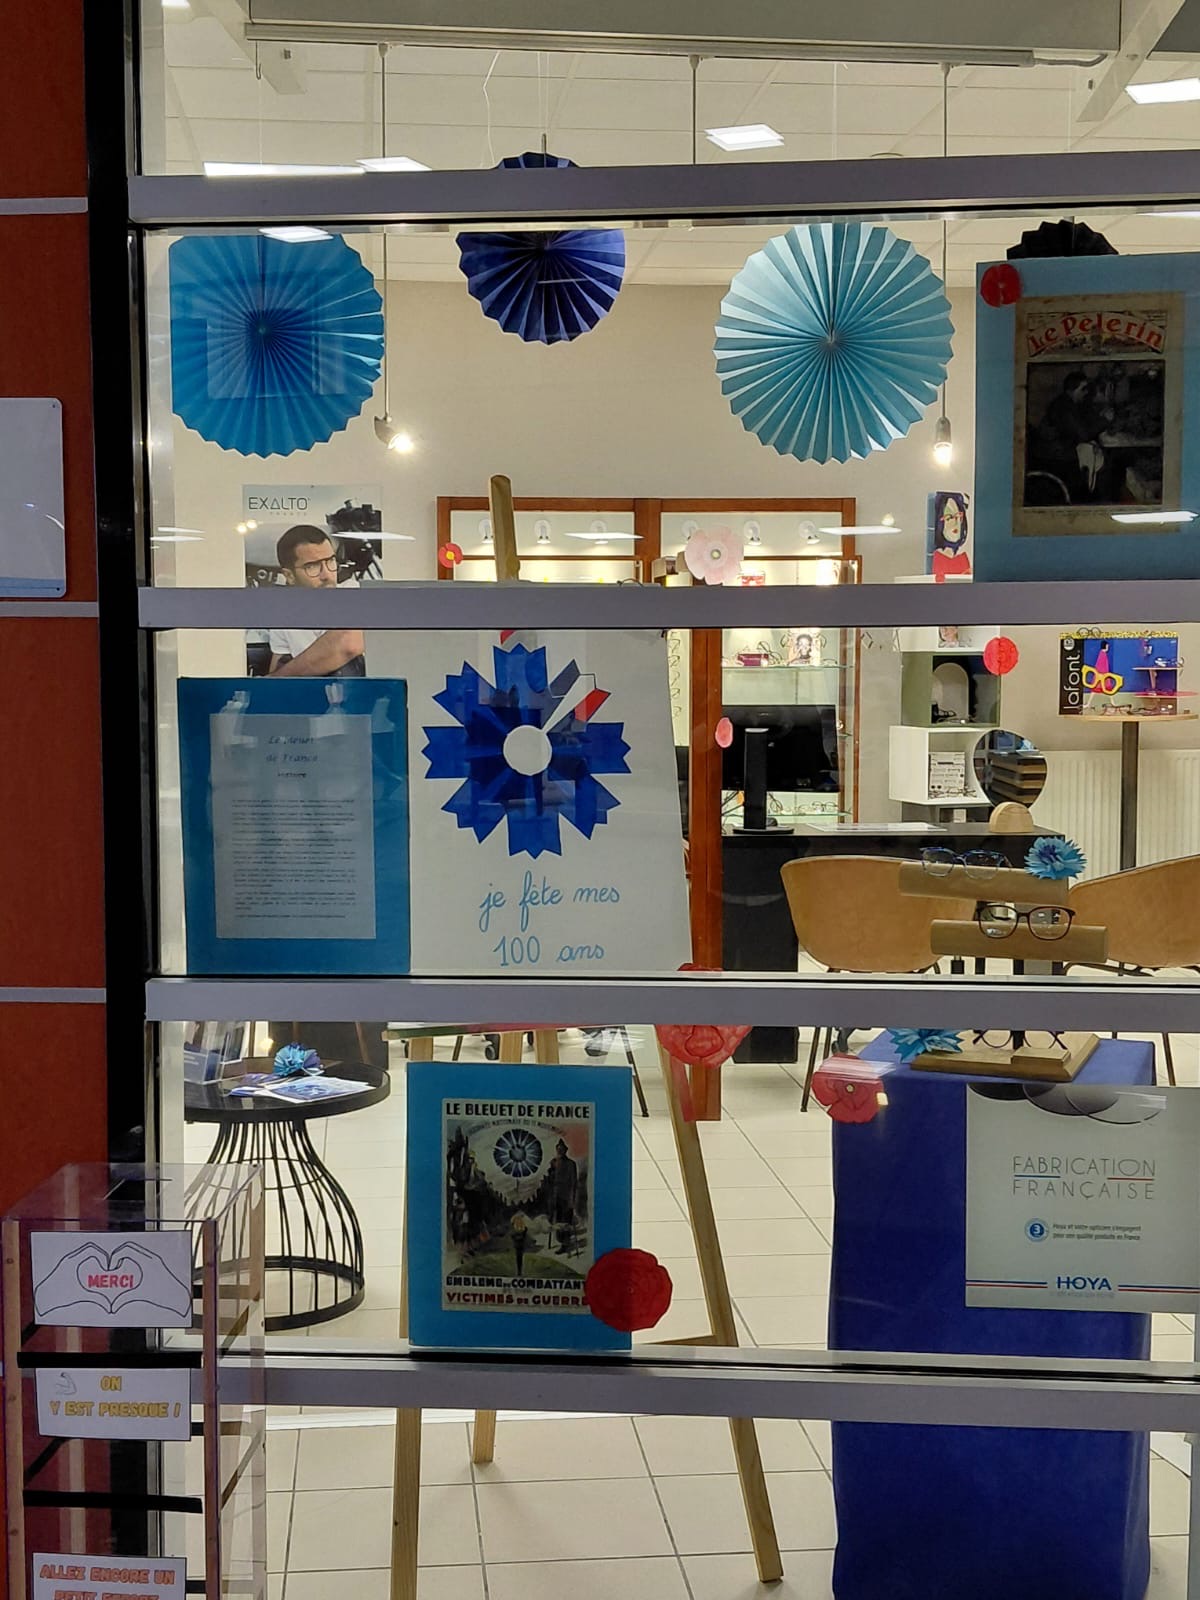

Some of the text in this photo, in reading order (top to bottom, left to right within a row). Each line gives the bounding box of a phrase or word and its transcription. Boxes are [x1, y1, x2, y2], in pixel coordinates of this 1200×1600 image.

[1029, 326, 1057, 350] Le
[248, 496, 308, 510] EXALTO
[479, 870, 620, 933] je fête mes
[493, 935, 604, 966] 100 ans
[446, 1102, 590, 1118] LE BLEUET DE FRANCE
[1012, 1156, 1156, 1177] FABRICATION
[1012, 1179, 1155, 1200] FRANÇAISE
[87, 1274, 134, 1288] MERCI
[1056, 1276, 1112, 1290] HOYA
[446, 1292, 514, 1304] VICTIMES
[100, 1375, 122, 1392] ON
[49, 1400, 61, 1416] Y
[64, 1401, 95, 1417] EST
[98, 1402, 170, 1418] PRESQUE
[39, 1564, 176, 1585] ALLEZ ENCORE UN
